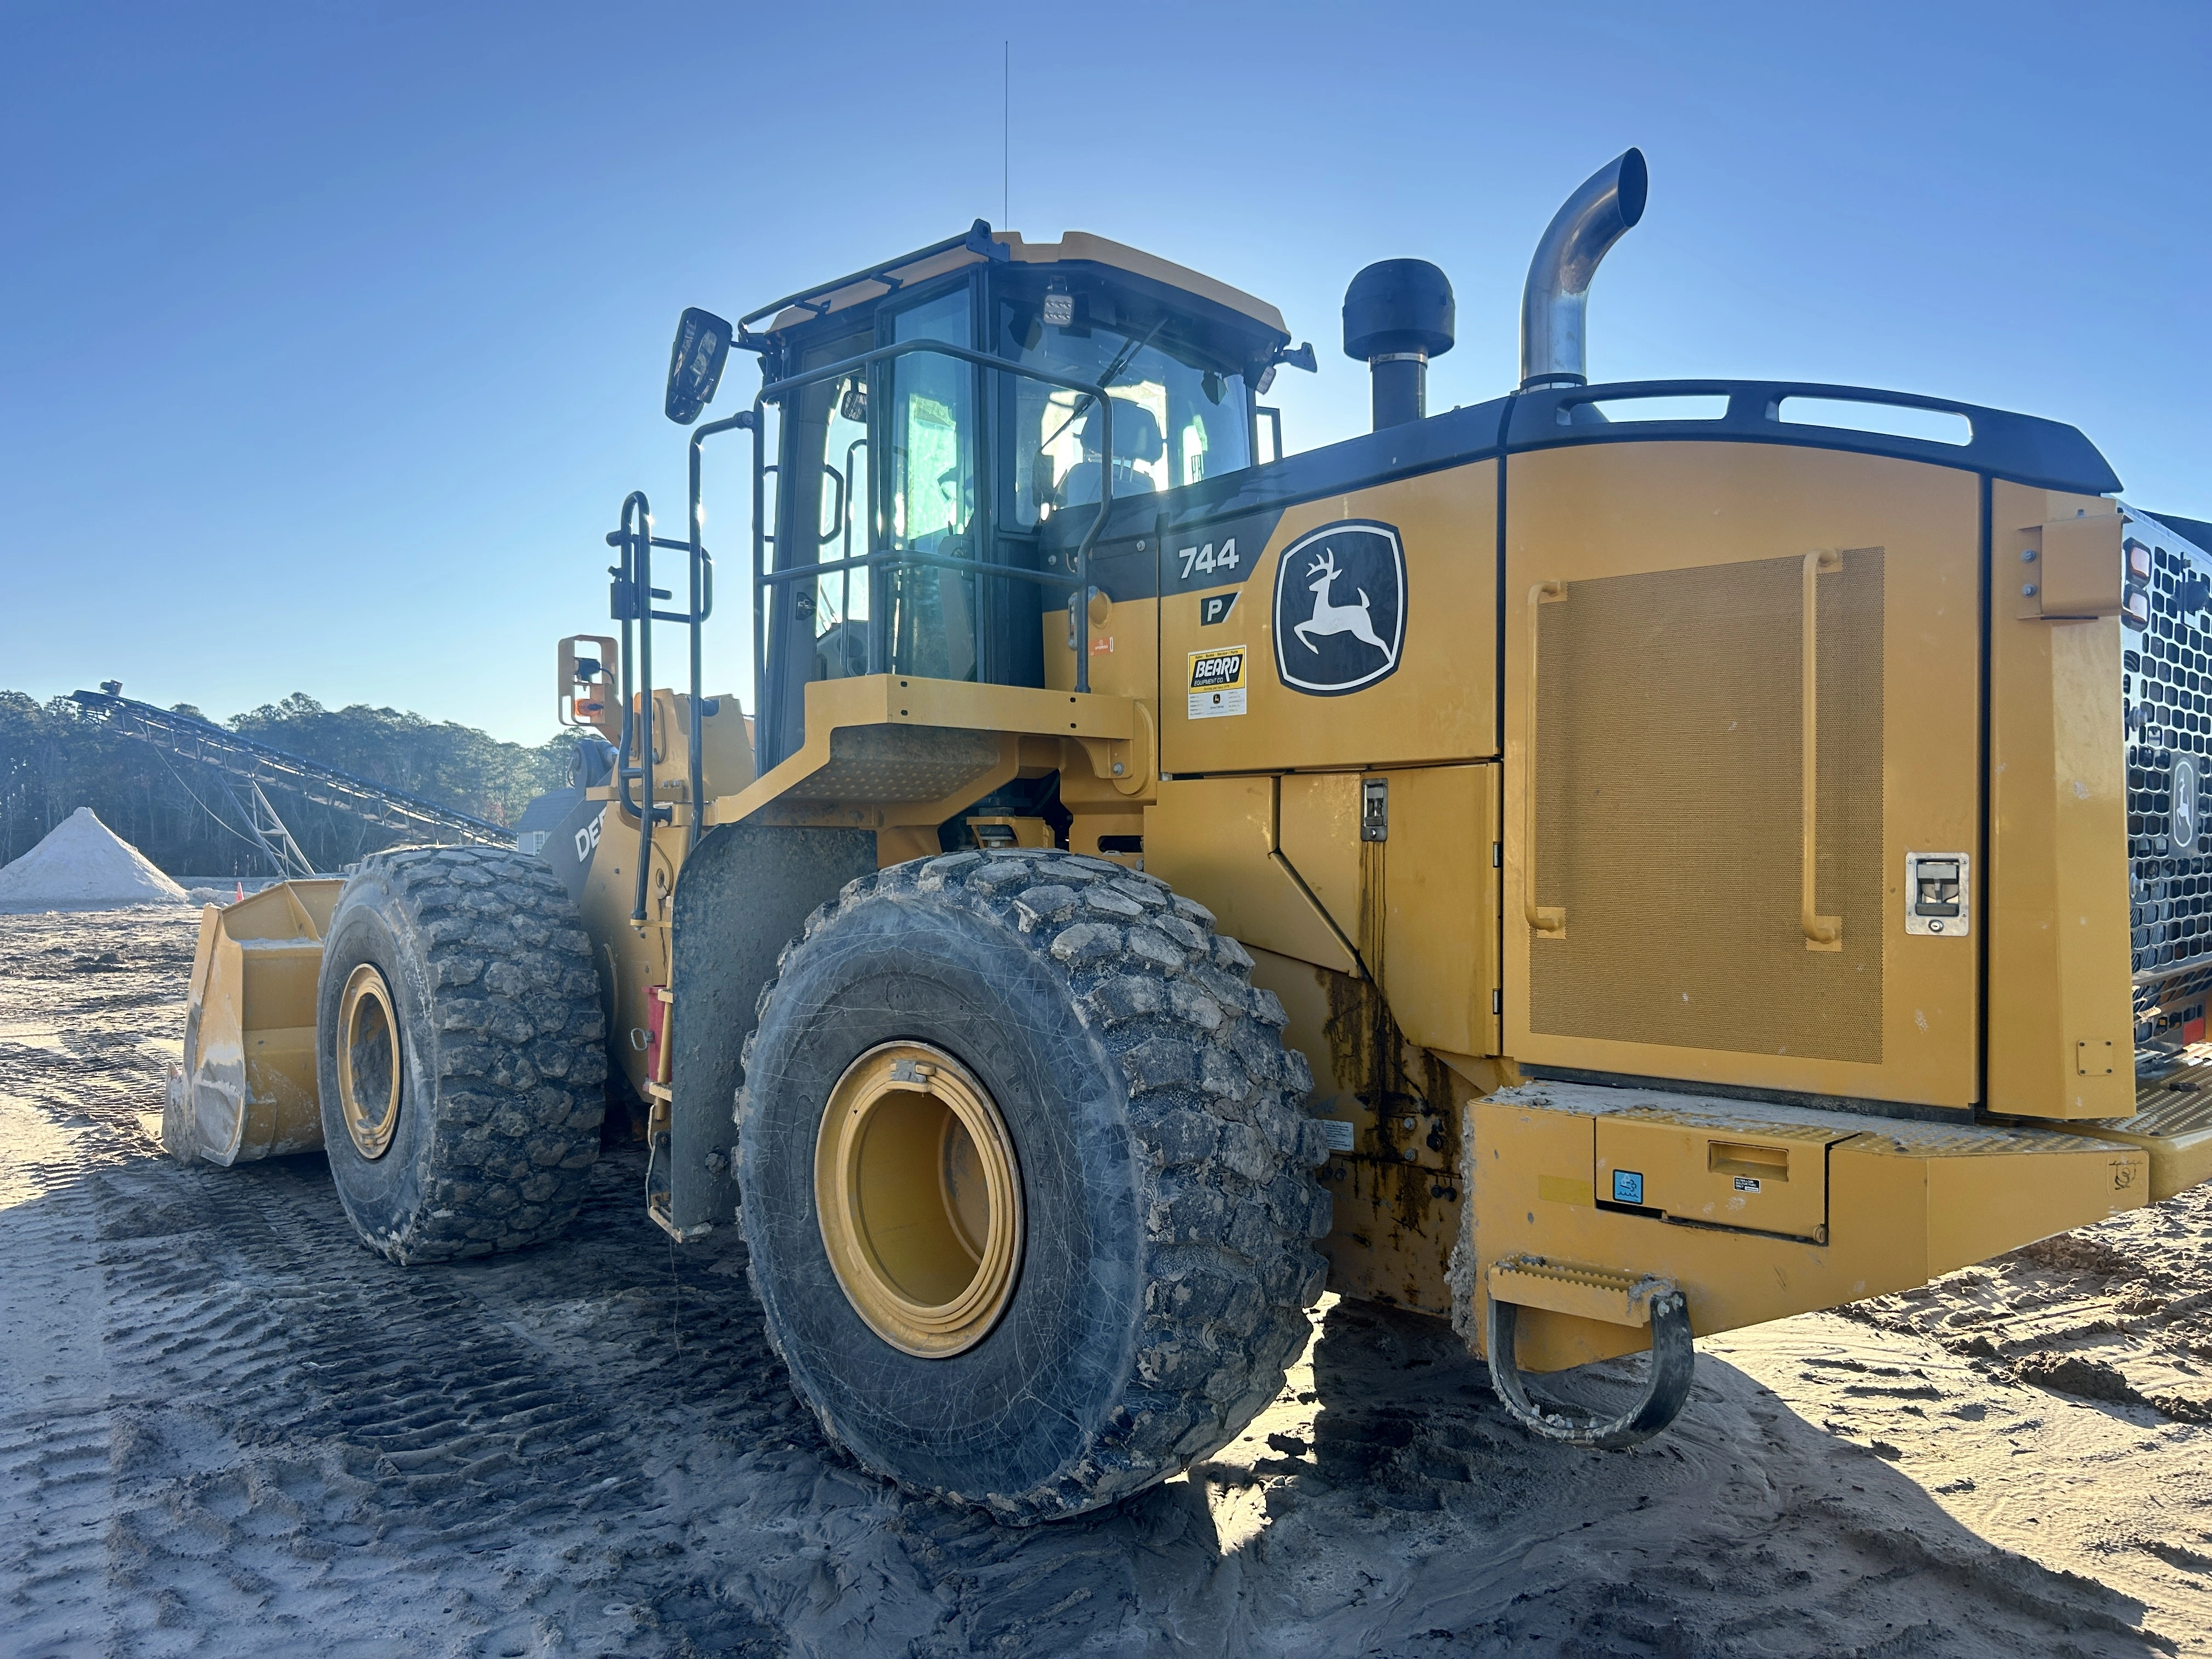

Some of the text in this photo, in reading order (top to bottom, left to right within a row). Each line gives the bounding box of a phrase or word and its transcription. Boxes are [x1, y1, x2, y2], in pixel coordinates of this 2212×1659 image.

[1179, 538, 1239, 579] 744
[1207, 599, 1223, 622] P
[1195, 656, 1240, 682] BEARD
[1194, 678, 1217, 687] EQUIPMENT
